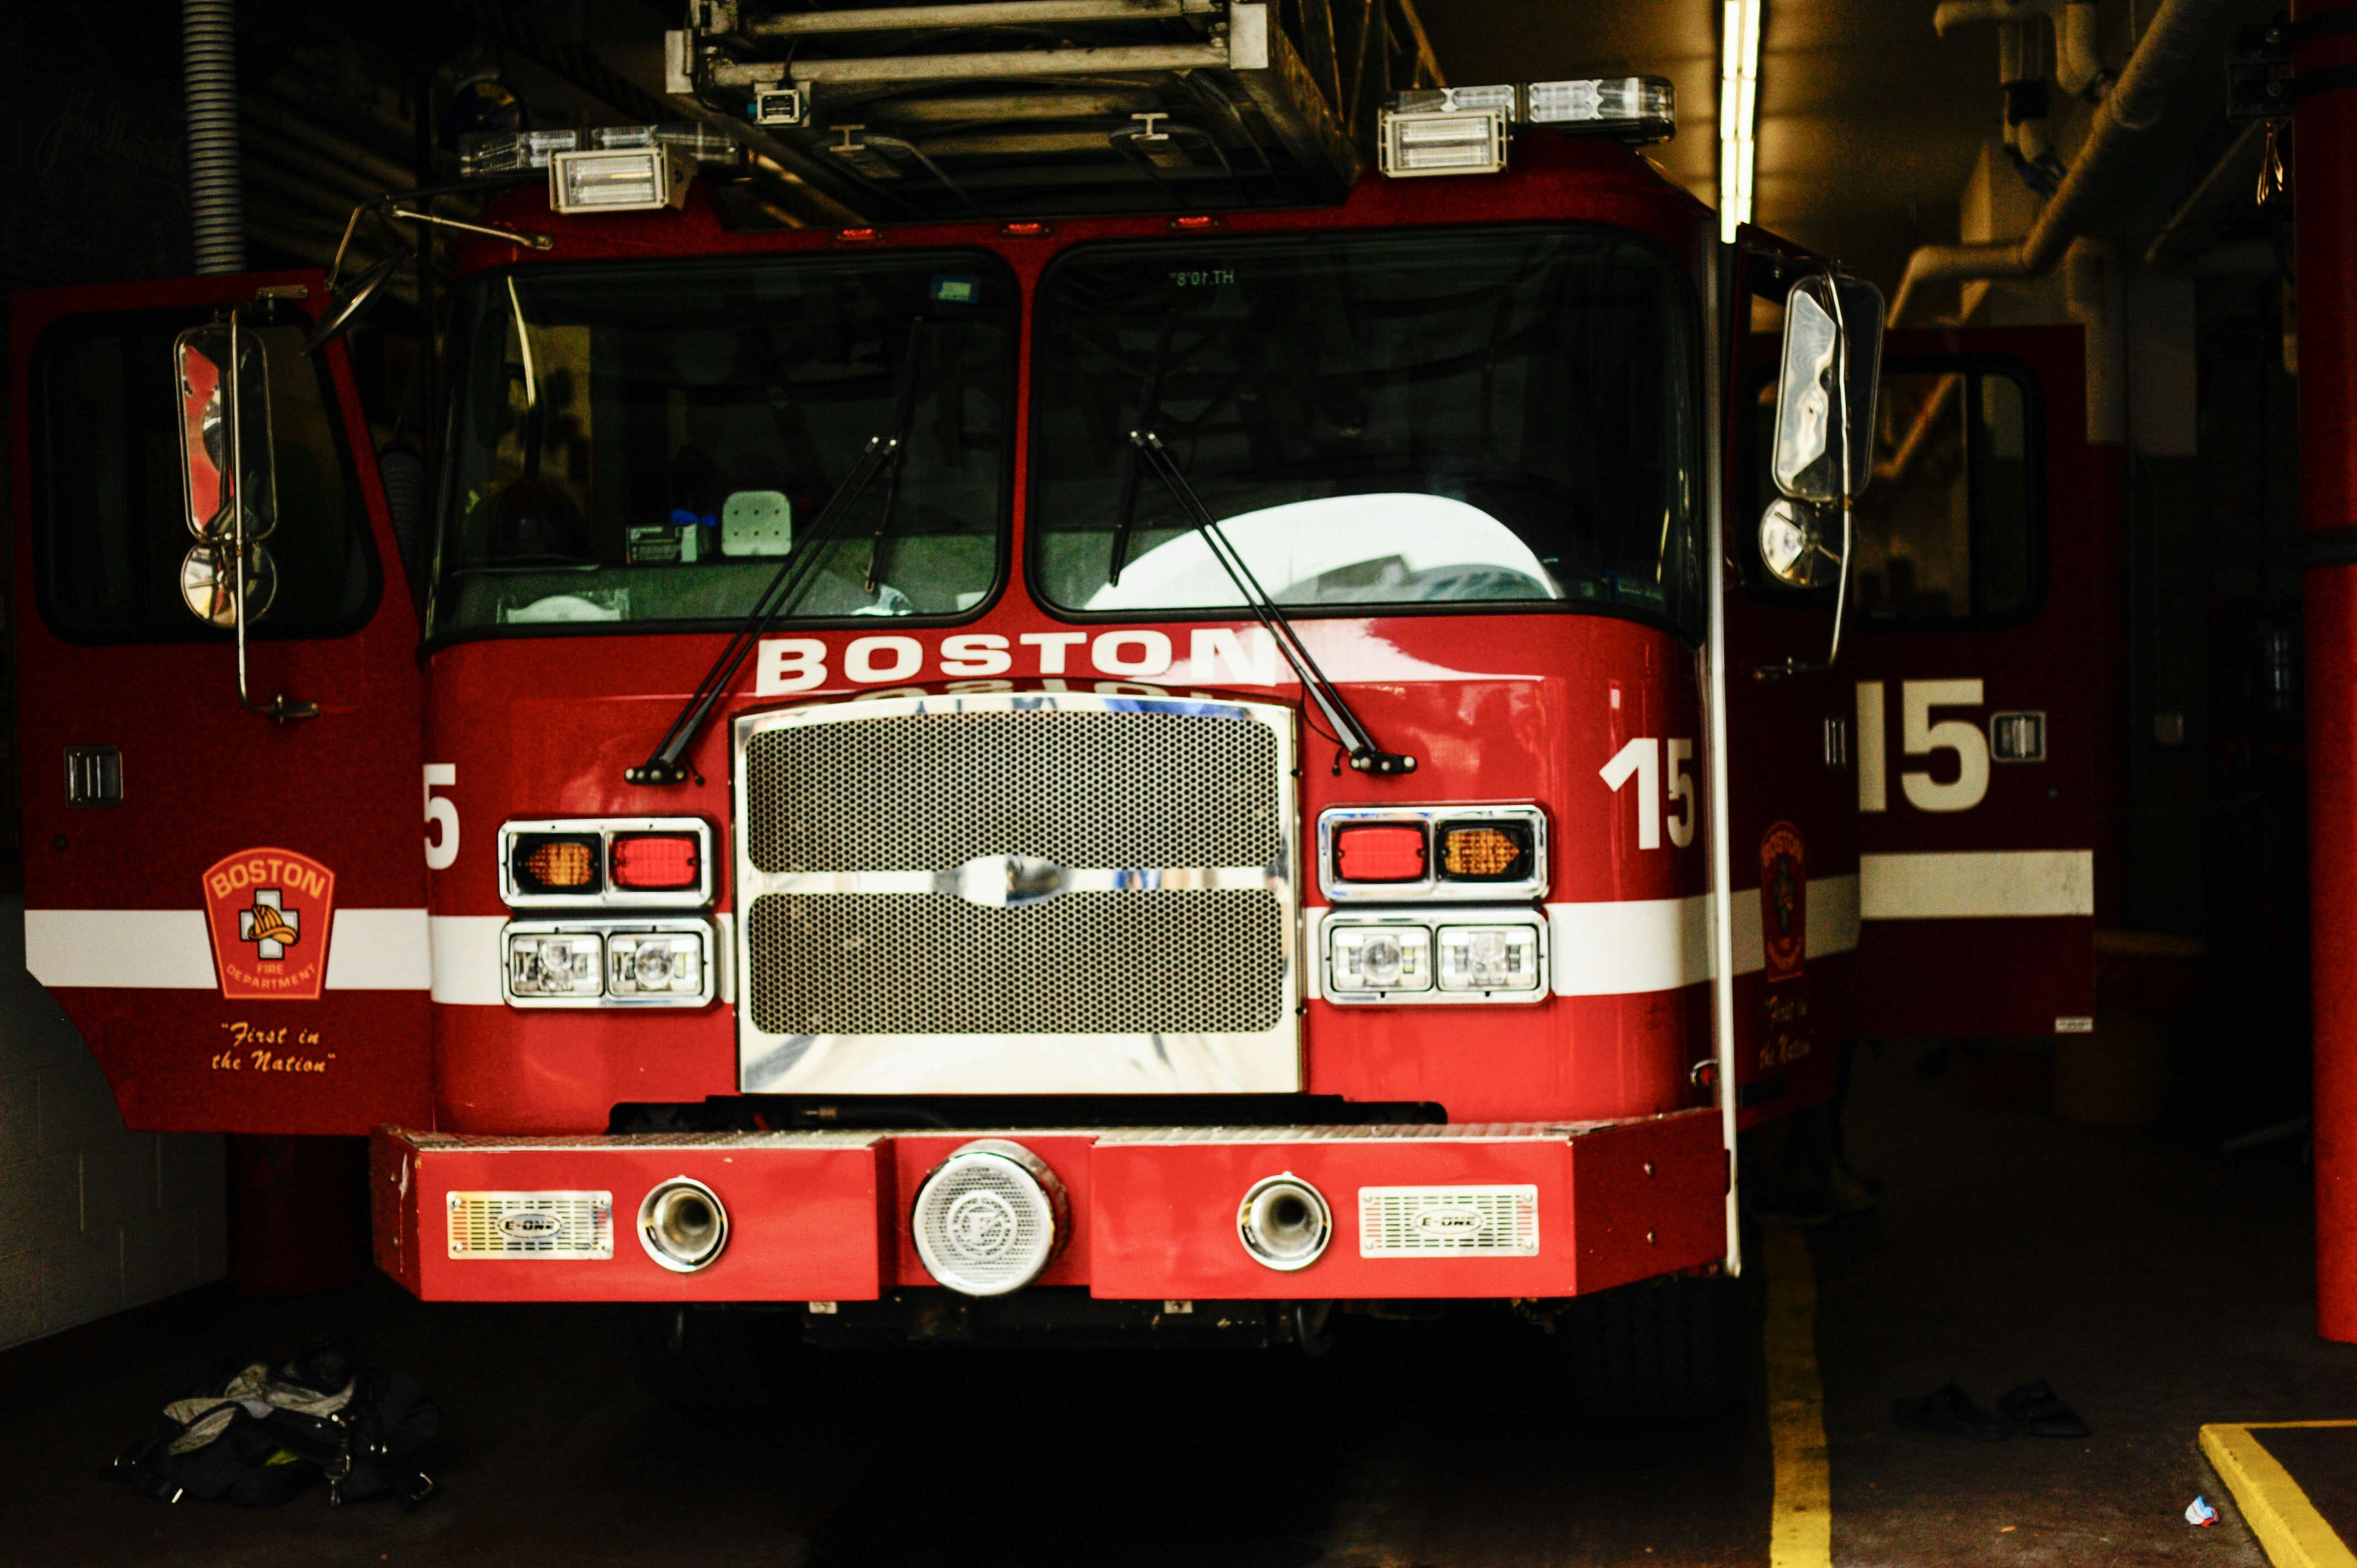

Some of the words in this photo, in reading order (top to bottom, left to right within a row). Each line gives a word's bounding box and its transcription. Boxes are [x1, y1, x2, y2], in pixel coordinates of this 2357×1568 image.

[755, 628, 1277, 697] BOSTON
[1856, 678, 1990, 813] 15
[1598, 737, 1695, 849] 15
[209, 859, 326, 900] BOSTON
[225, 963, 316, 989] DEPARTMENT
[256, 964, 284, 975] FIRE
[298, 1028, 320, 1045] in
[212, 1050, 242, 1071] the
[505, 1221, 554, 1230] E-ONE
[1423, 1217, 1475, 1226] E-ONE
